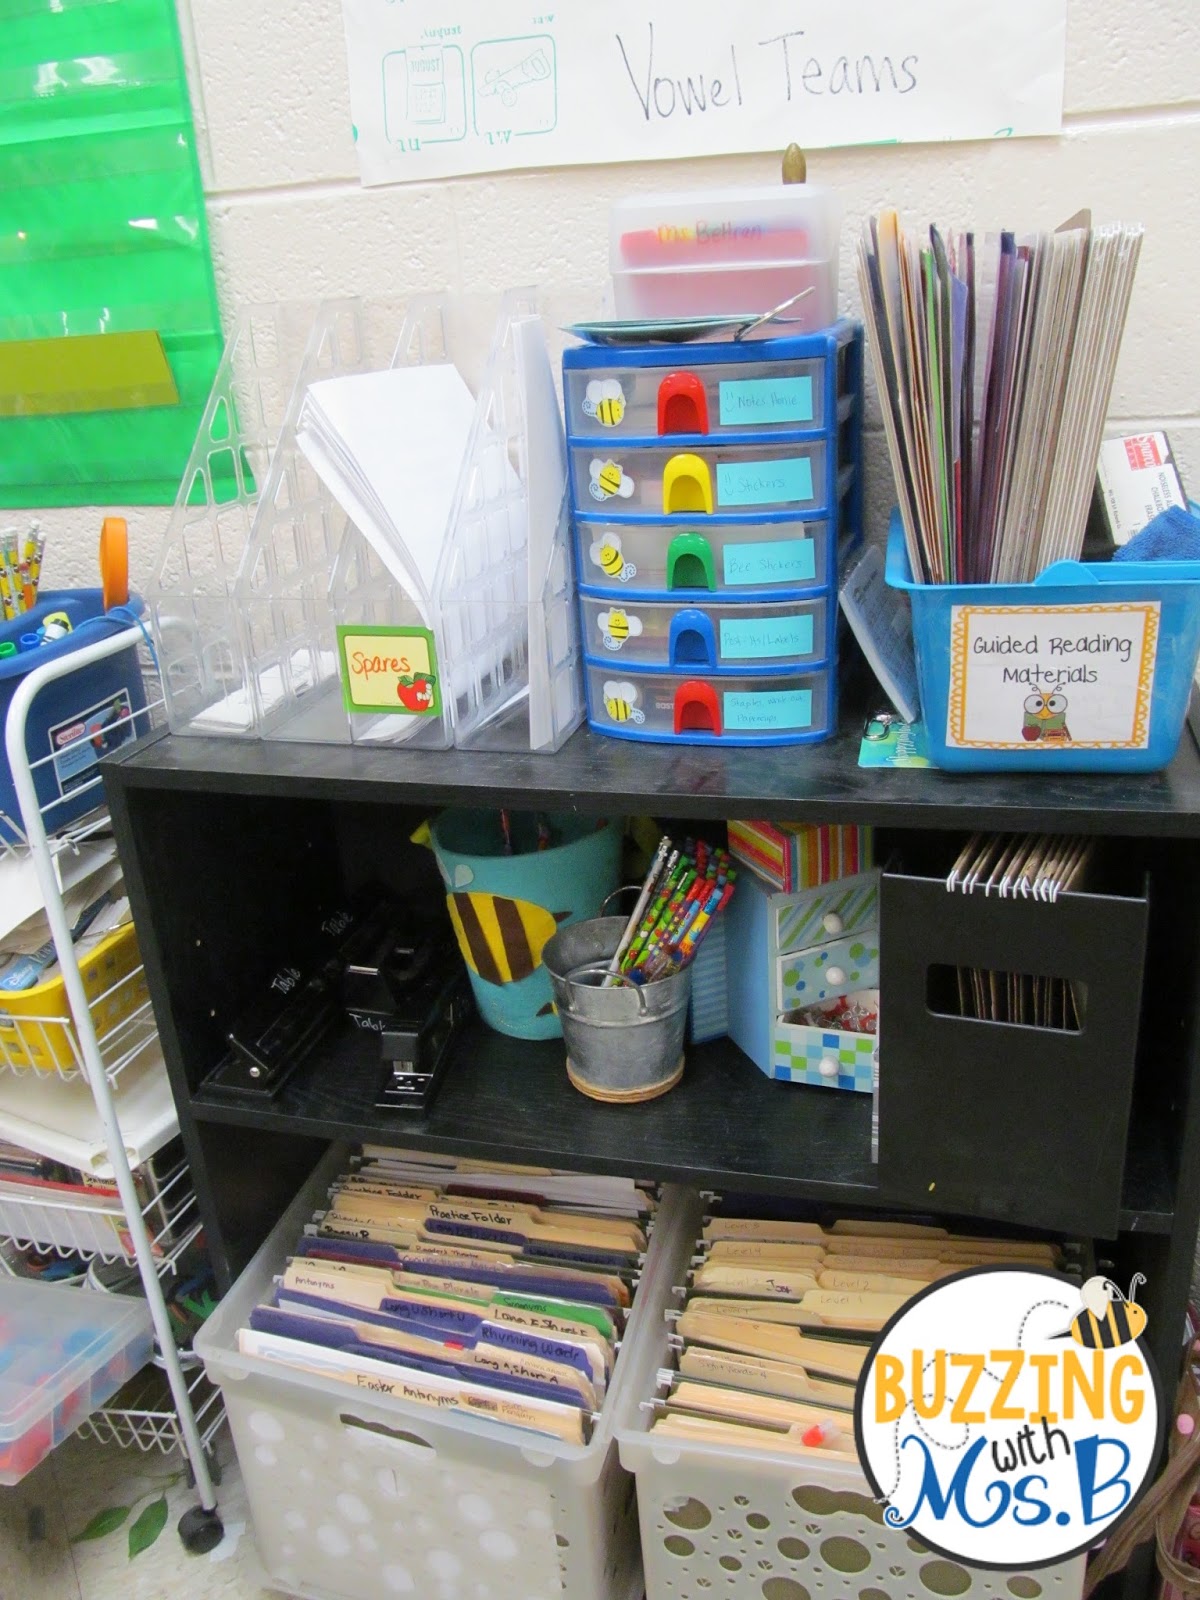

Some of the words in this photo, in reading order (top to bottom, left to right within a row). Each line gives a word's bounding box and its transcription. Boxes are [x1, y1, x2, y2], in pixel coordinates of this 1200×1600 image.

[615, 22, 743, 121] Vowel
[758, 31, 919, 101] Teams
[729, 559, 751, 574] Bee
[973, 634, 1039, 655] Guided
[1048, 633, 1133, 663] Reading
[351, 651, 411, 680] Spares
[1002, 663, 1099, 684] Materials
[321, 911, 353, 936] Table
[271, 967, 301, 994] Table
[386, 1188, 422, 1200] Folder
[429, 1204, 470, 1221] Practice
[471, 1211, 512, 1225] Folder
[295, 1276, 335, 1290] Antonyms
[833, 1278, 860, 1288] Level
[863, 1279, 871, 1290] 2
[820, 1295, 849, 1304] Level
[474, 1355, 499, 1370] Long
[549, 1376, 559, 1384] A
[356, 1374, 395, 1394] Easter
[403, 1386, 459, 1406] Antonyms
